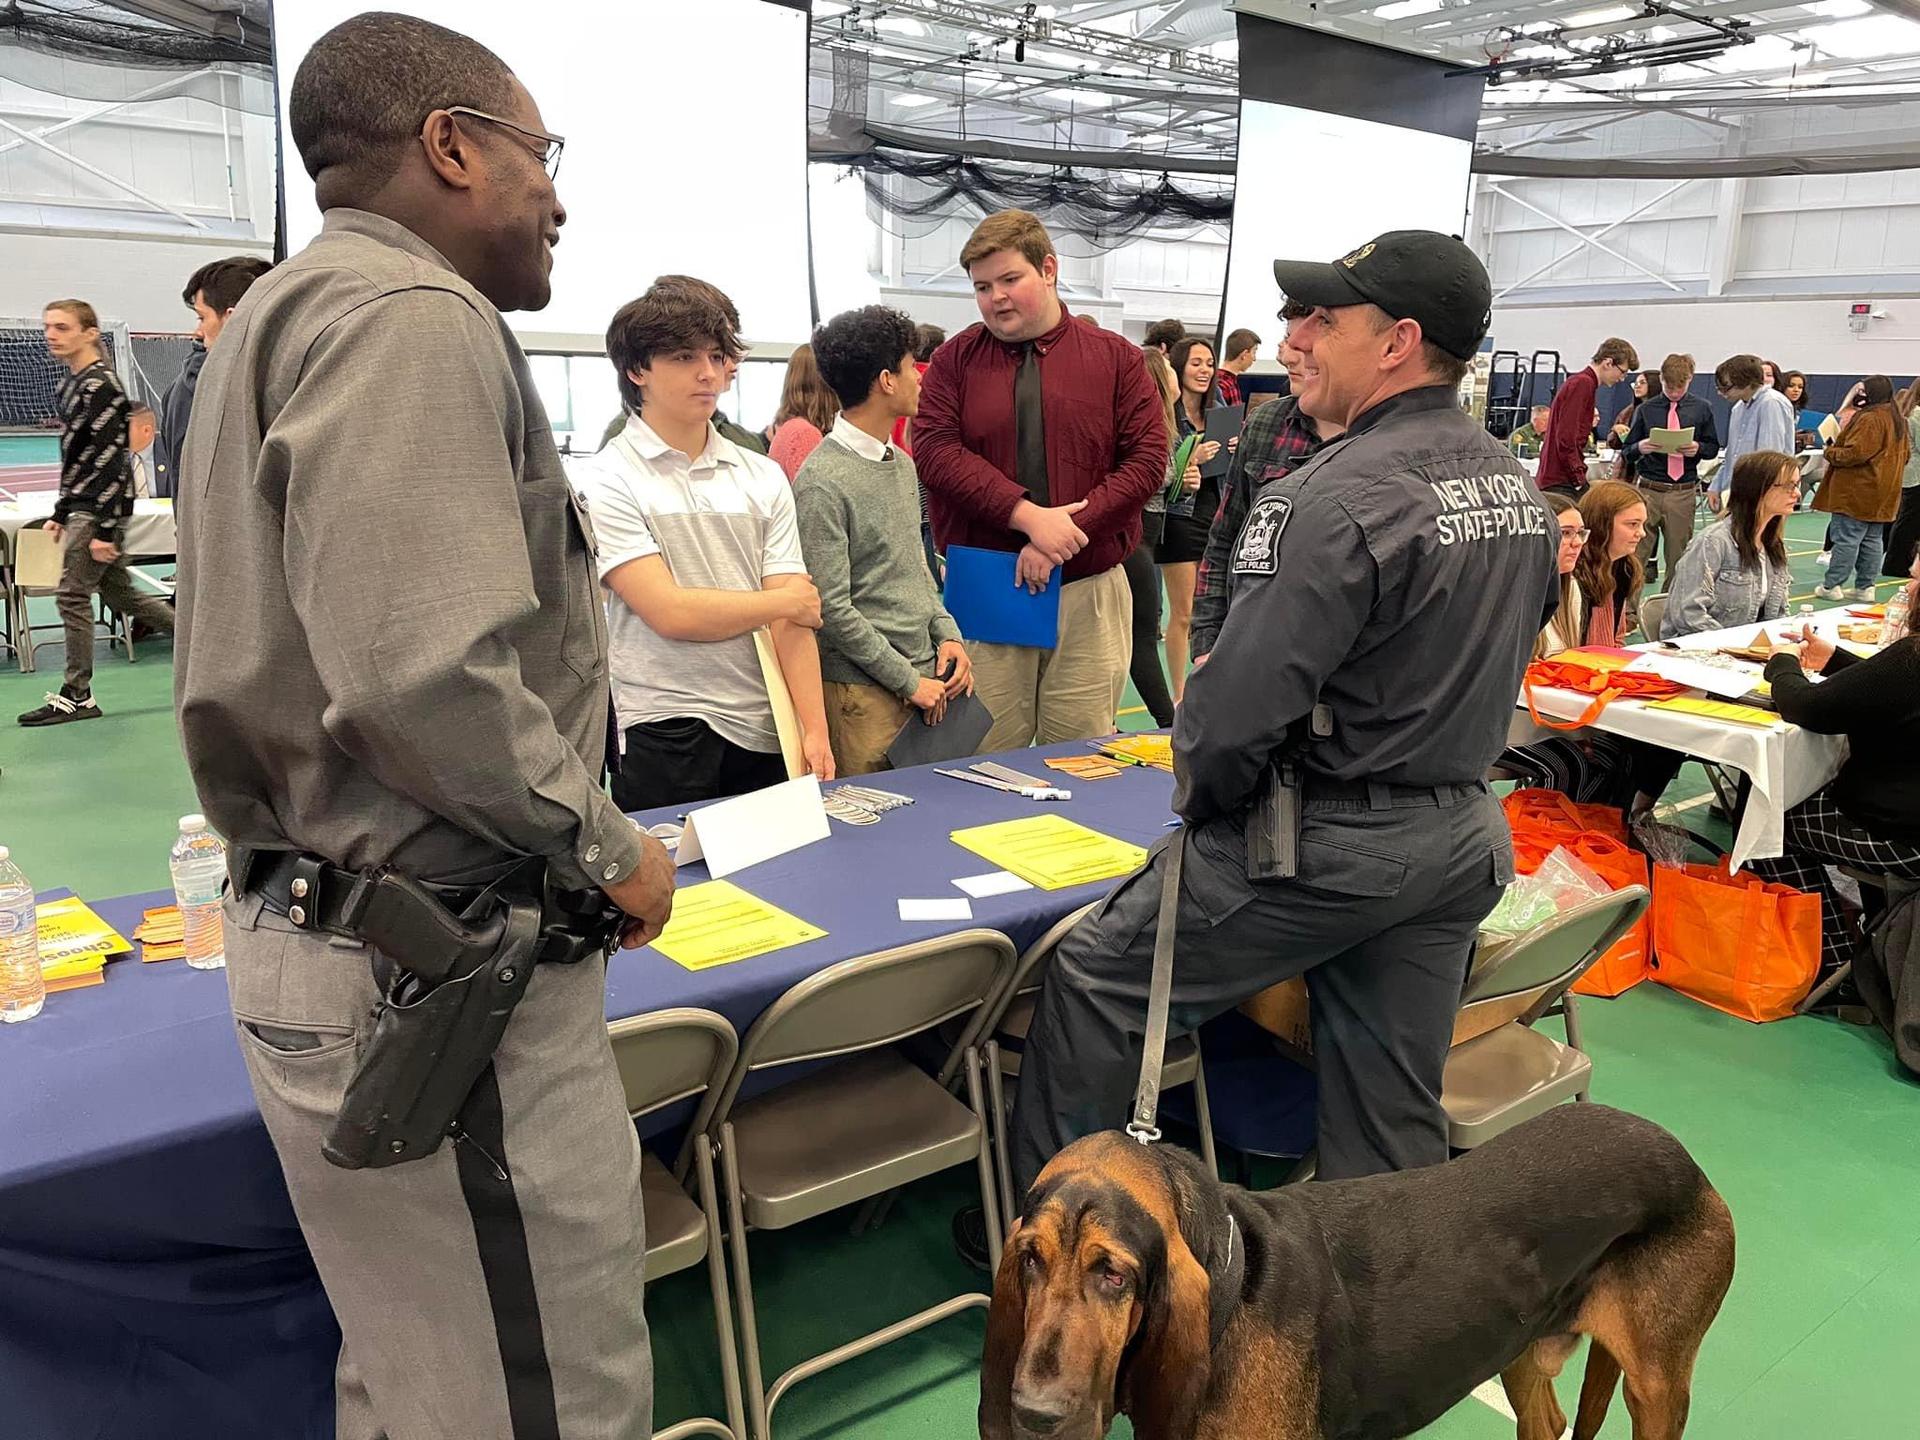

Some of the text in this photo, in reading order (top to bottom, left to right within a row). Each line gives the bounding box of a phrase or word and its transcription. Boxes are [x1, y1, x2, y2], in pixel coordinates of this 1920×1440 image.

[1431, 474, 1536, 511] NEW YORK
[1436, 506, 1546, 546] STATE POLICE
[1248, 561, 1271, 570] POLICE
